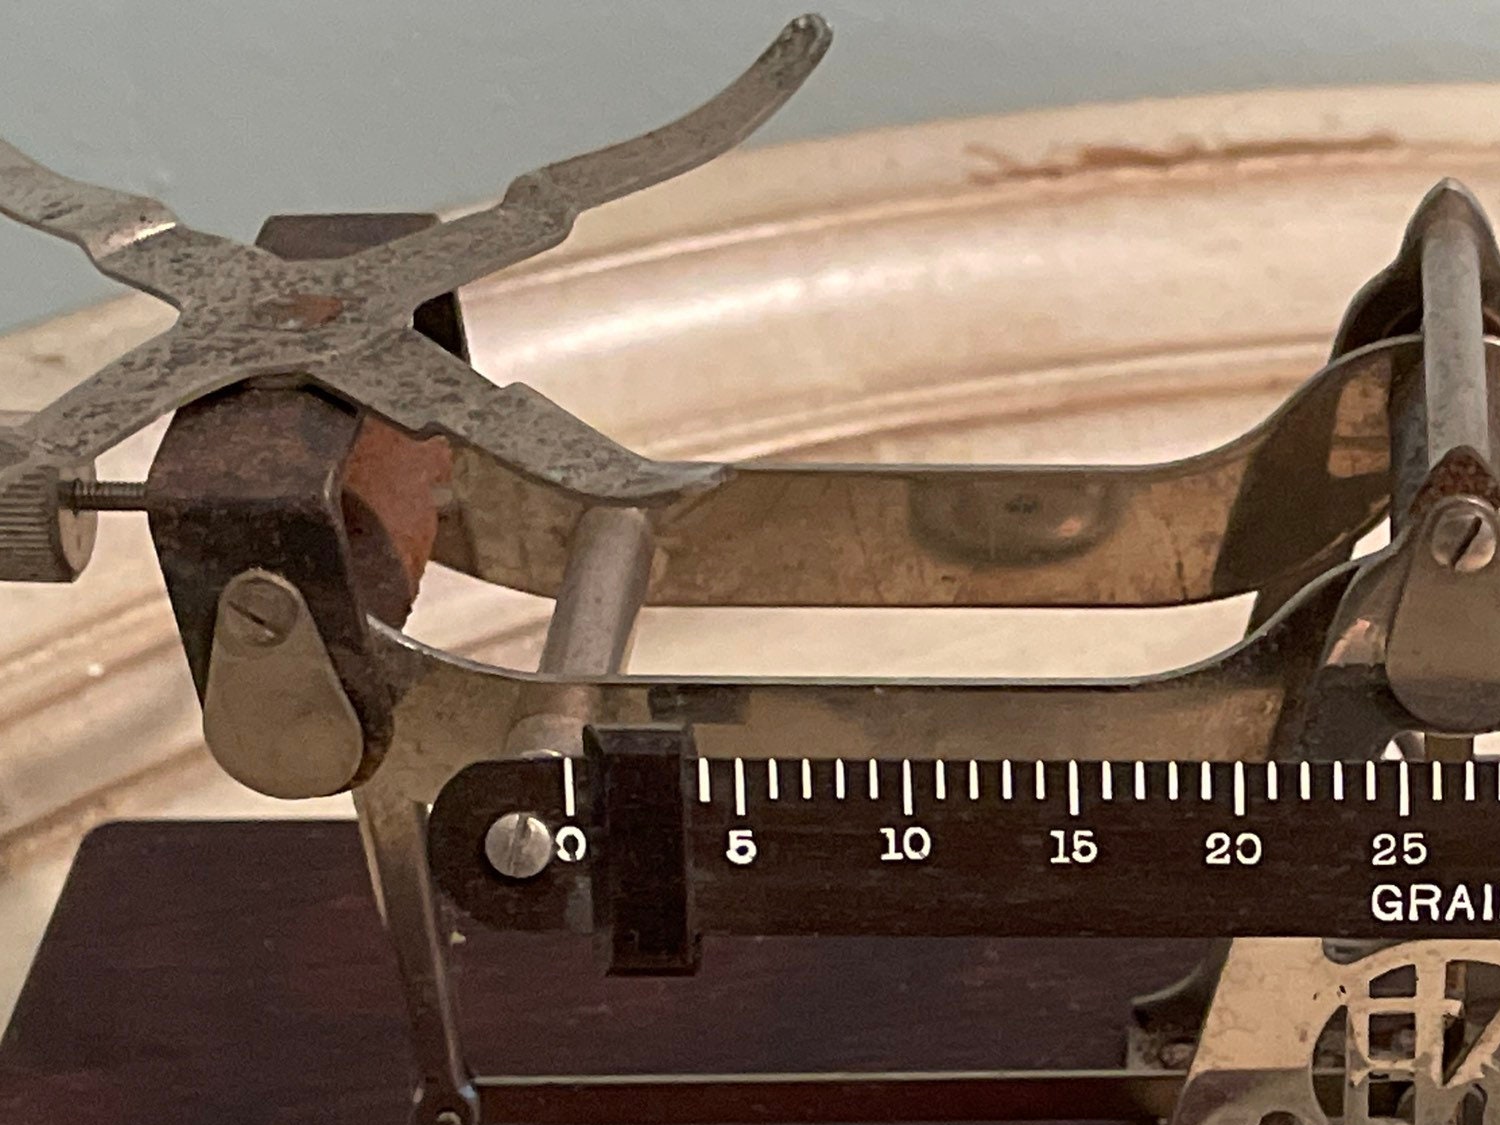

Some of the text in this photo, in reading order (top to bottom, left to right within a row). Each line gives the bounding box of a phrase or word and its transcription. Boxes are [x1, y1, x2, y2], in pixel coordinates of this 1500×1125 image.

[725, 829, 757, 865] 5
[879, 826, 931, 861] 10
[1050, 829, 1098, 864] 15
[1205, 832, 1262, 865] 20
[1371, 832, 1427, 866] 25
